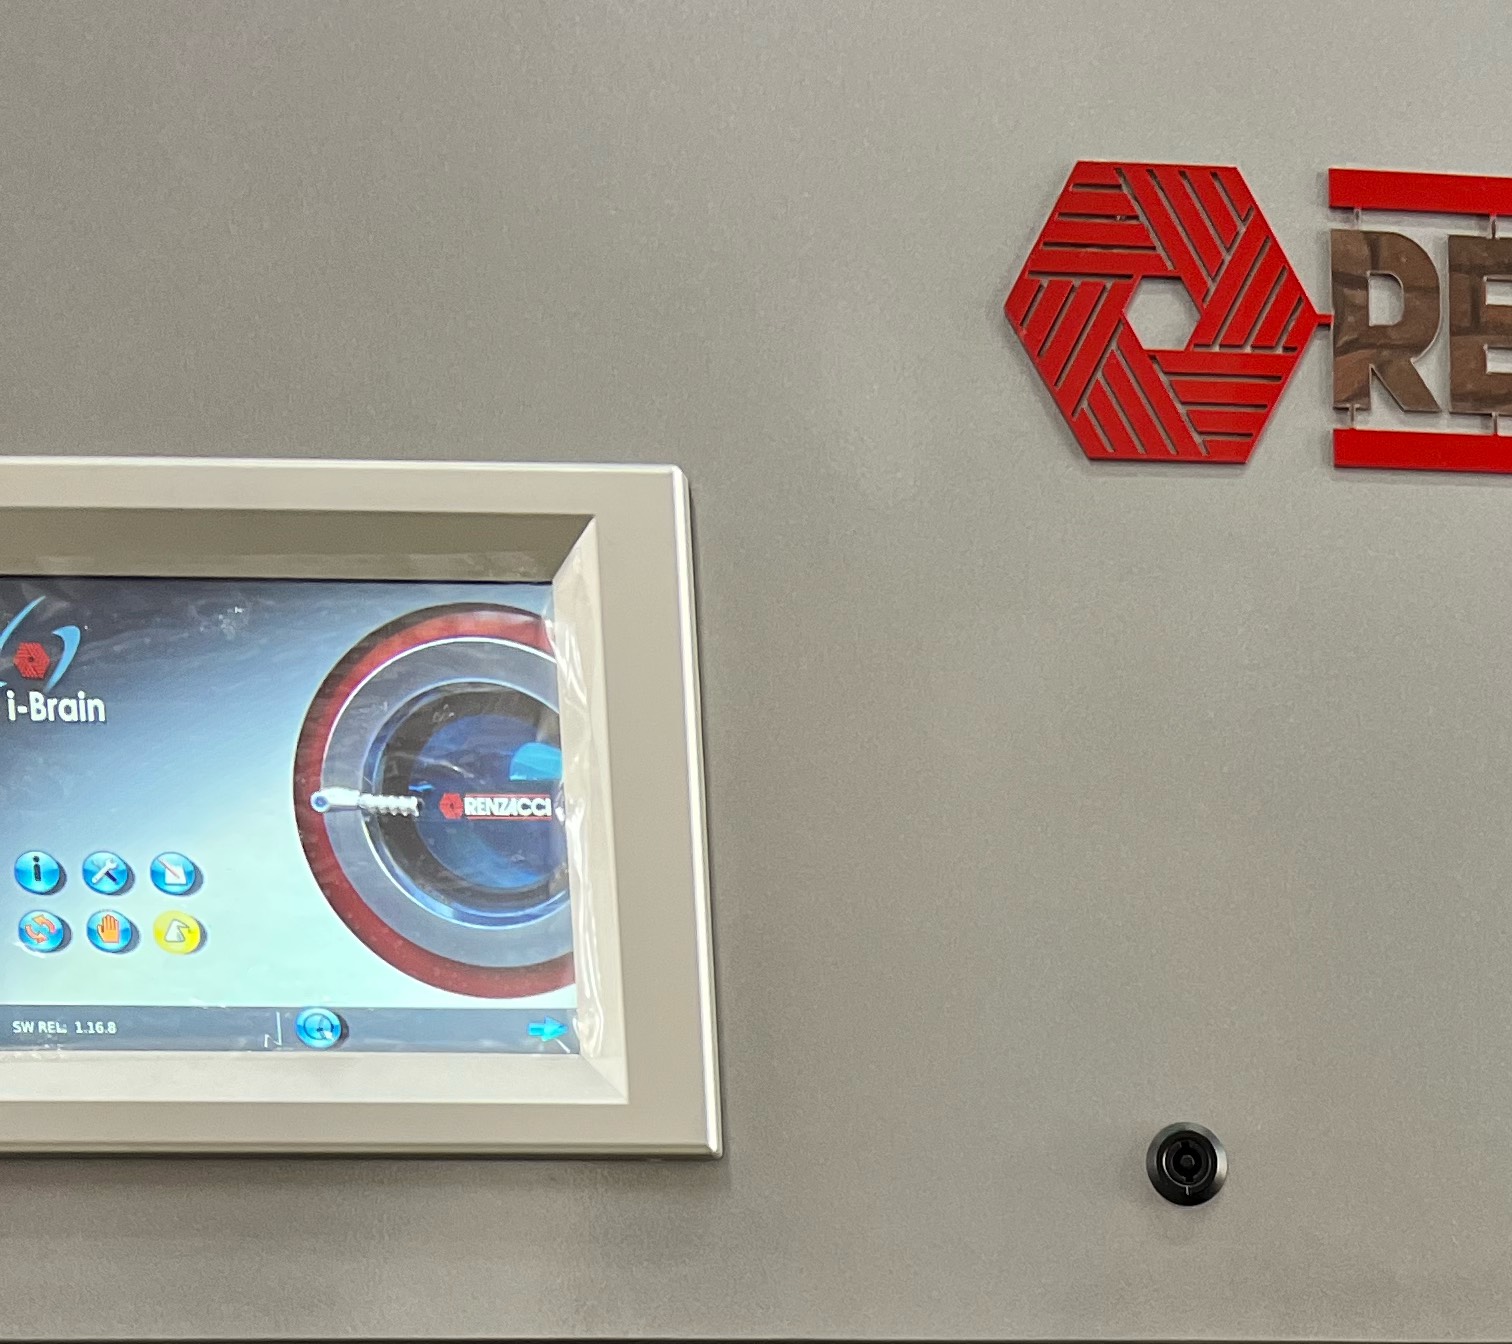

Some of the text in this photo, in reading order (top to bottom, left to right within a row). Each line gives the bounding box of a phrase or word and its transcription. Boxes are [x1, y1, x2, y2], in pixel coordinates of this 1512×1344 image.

[6, 690, 106, 722] i-Brain
[464, 797, 552, 816] RENZACCI
[12, 1021, 34, 1033] SW
[75, 1021, 117, 1034] 1.16.8
